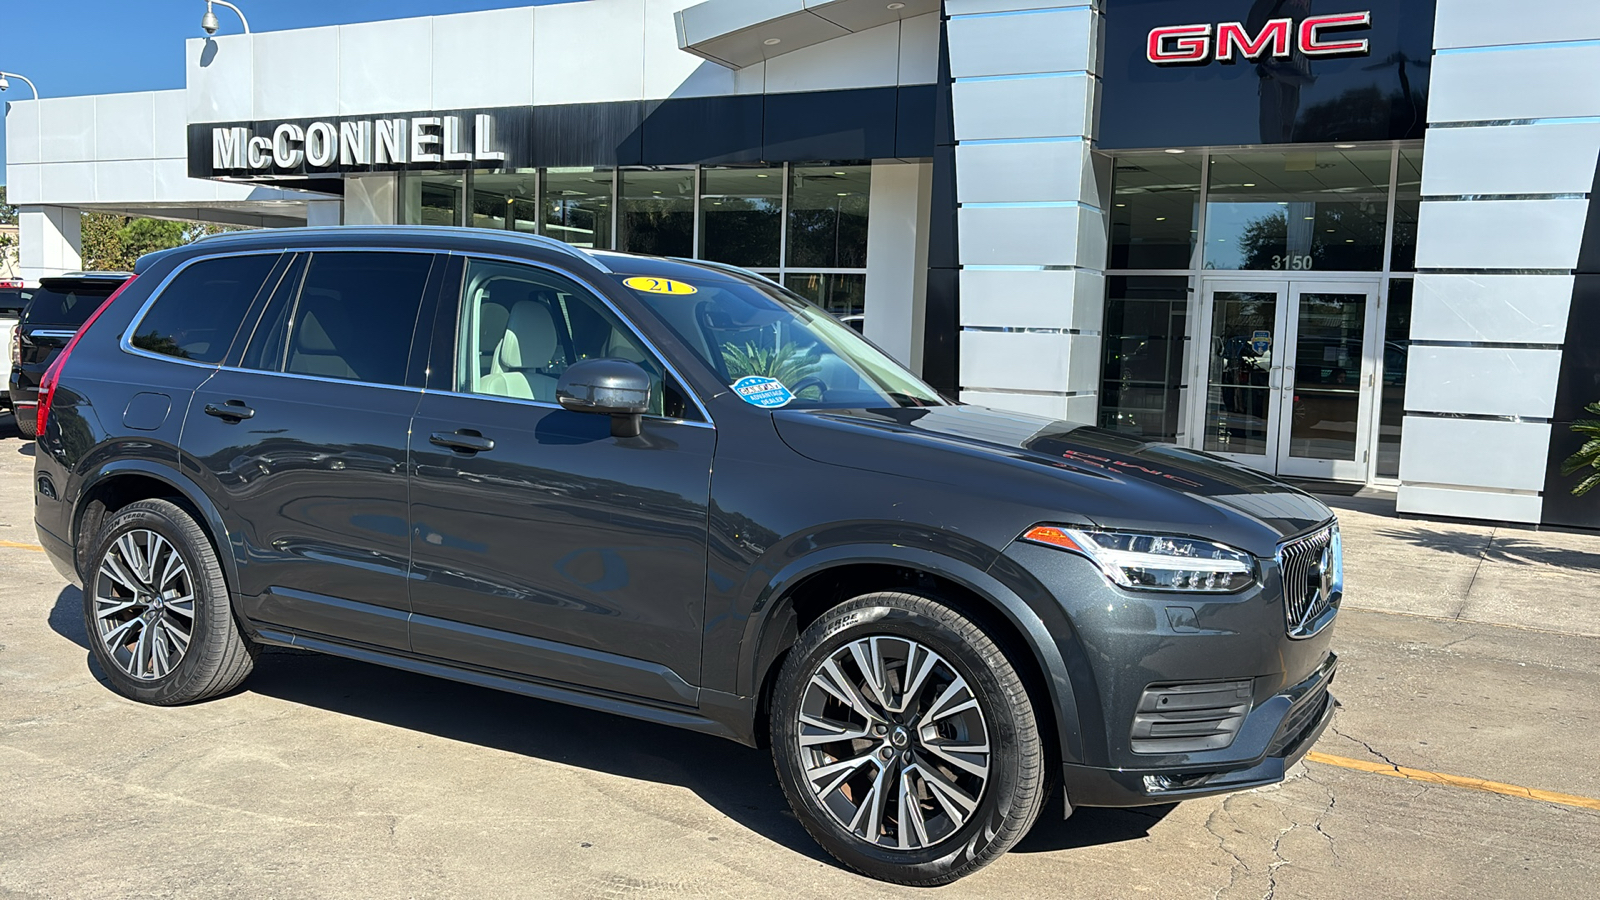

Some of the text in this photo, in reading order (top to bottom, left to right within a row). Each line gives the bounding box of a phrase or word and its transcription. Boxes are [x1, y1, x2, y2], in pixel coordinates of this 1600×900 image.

[1147, 11, 1371, 63] GMC
[212, 114, 505, 169] McCONNELL
[1271, 255, 1312, 270] 3150
[646, 279, 673, 292] 21
[123, 513, 146, 521] VERDE
